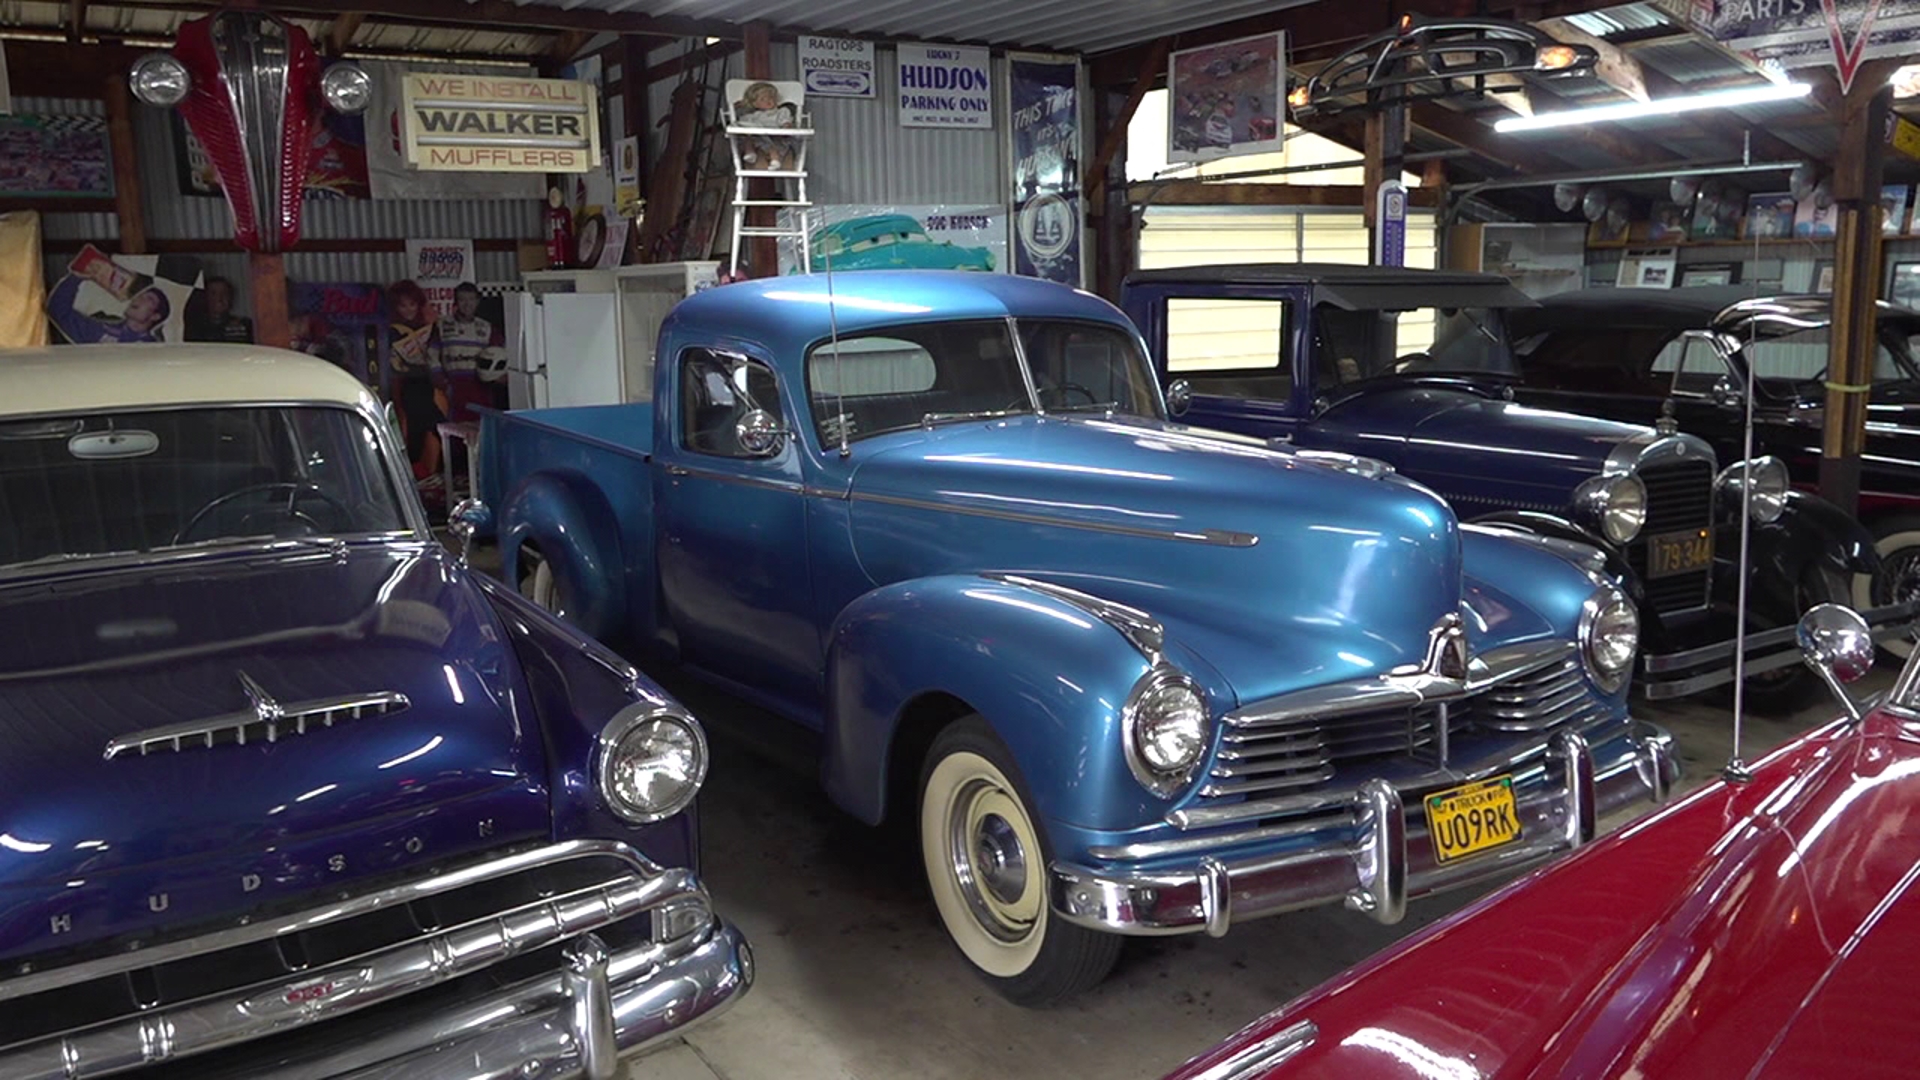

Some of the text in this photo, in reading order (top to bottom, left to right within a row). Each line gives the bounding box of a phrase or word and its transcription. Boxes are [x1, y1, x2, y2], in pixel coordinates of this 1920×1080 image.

[1723, 0, 1806, 22] PARTS
[808, 38, 864, 52] RAGTOPS
[926, 49, 953, 60] LUCKY
[802, 57, 872, 71] ROADSTERS
[901, 65, 988, 91] HUDSON
[417, 79, 577, 100] WE INSTALL
[901, 94, 988, 112] PARKING ONLY
[416, 110, 581, 136] WALKER
[1014, 101, 1042, 129] THIS
[431, 149, 575, 166] MUFFLERS
[1455, 795, 1487, 810] TRUCK
[50, 819, 494, 935] HUDSON
